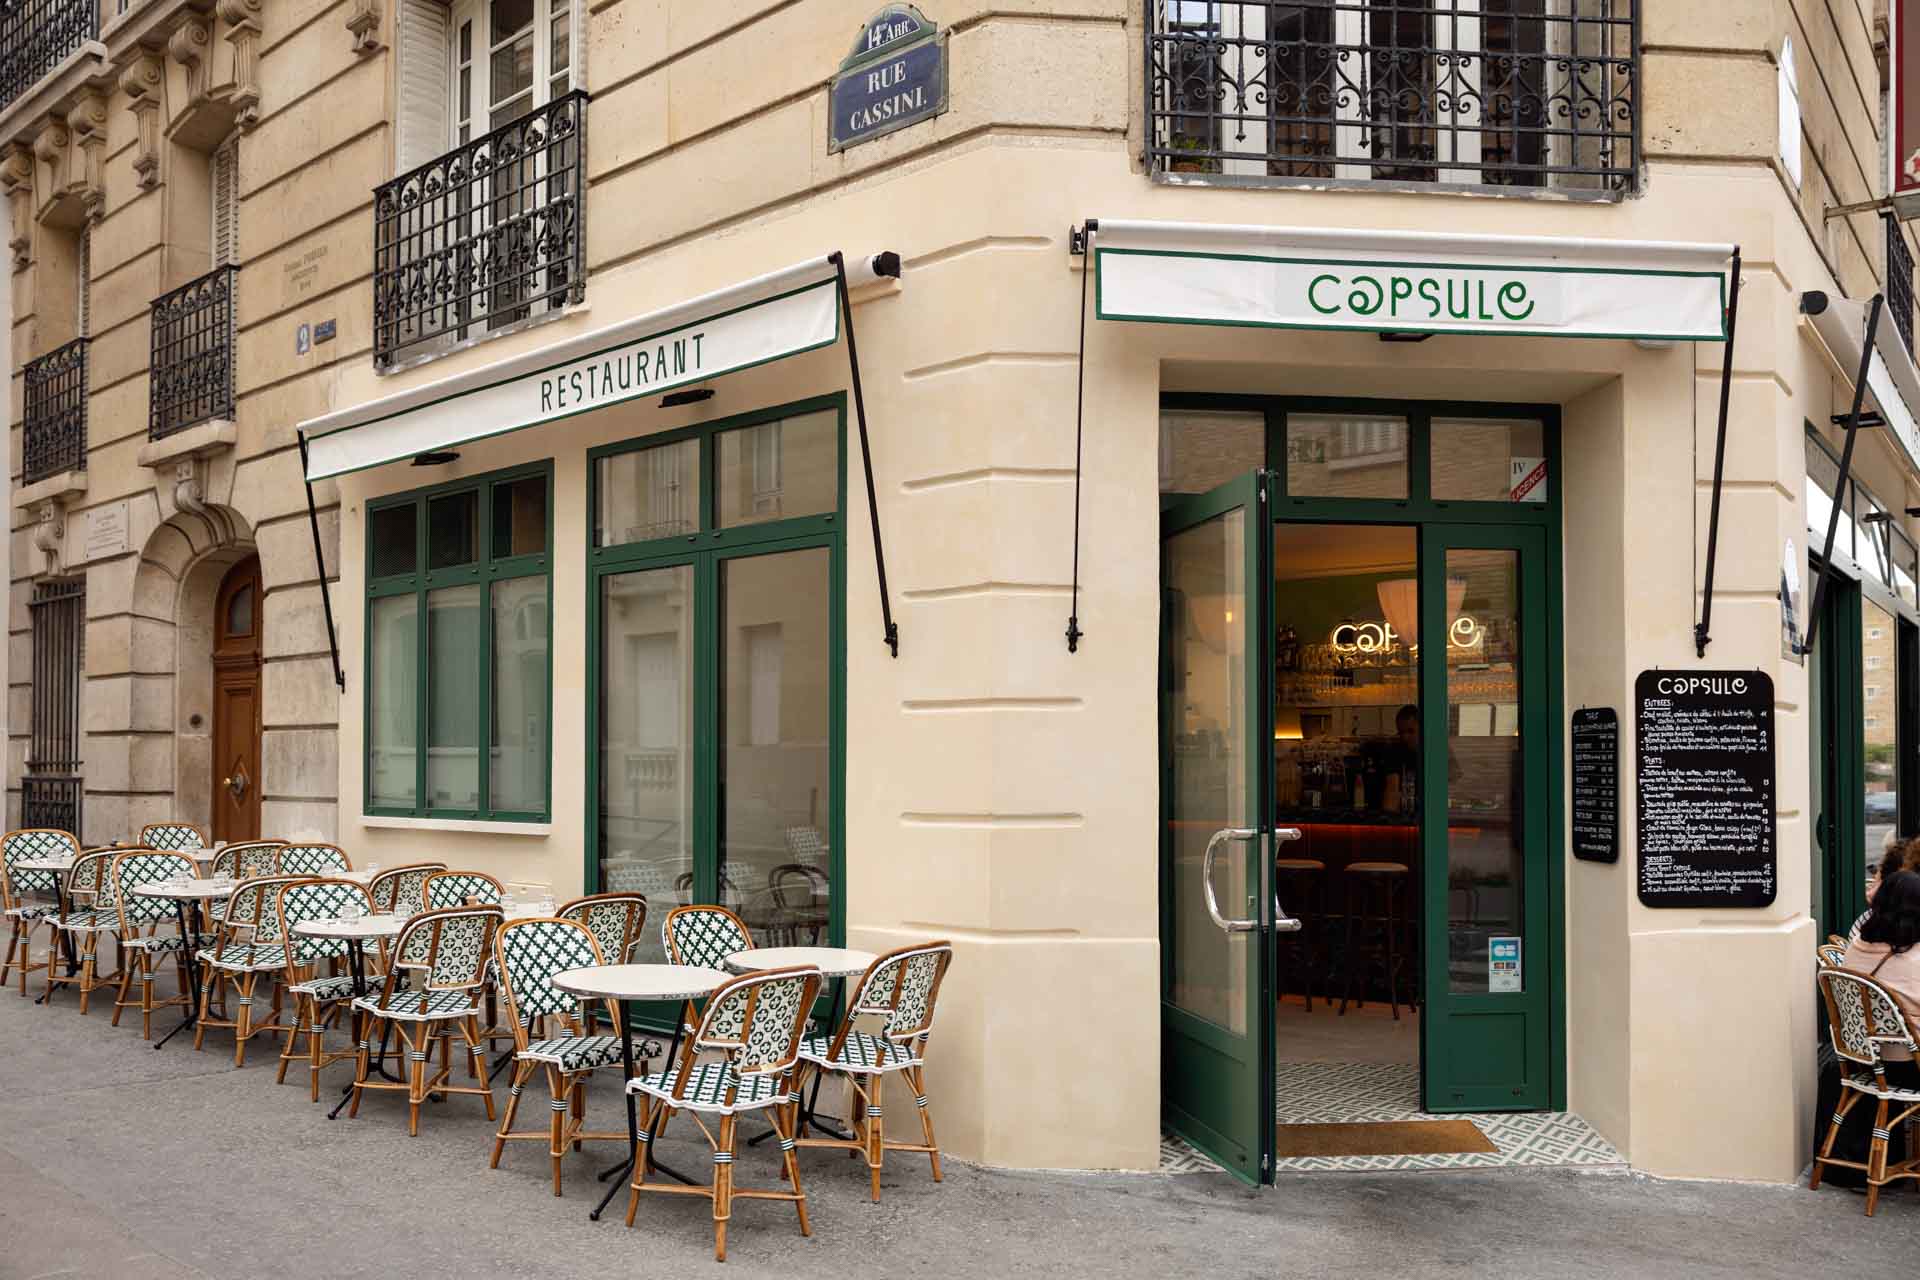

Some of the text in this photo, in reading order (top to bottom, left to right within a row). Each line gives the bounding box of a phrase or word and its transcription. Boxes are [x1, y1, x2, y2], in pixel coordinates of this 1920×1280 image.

[867, 60, 906, 94] RUE
[541, 332, 705, 413] RESTAURANT
[1512, 462, 1527, 475] IV
